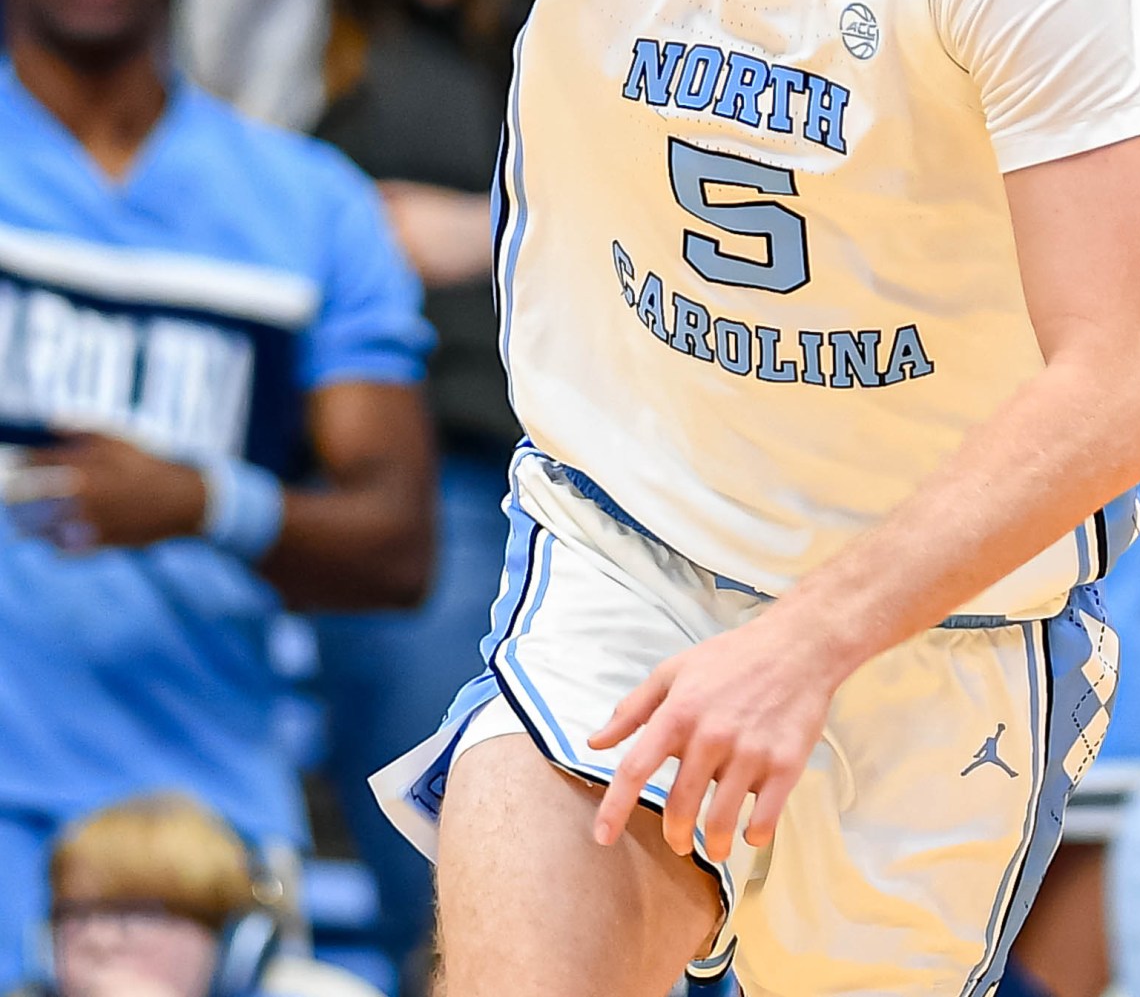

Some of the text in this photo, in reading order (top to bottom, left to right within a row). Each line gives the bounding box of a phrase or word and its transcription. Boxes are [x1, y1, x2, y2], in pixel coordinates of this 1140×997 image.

[846, 22, 877, 37] ACC
[622, 38, 850, 155] NORTH
[667, 136, 811, 294] 5
[612, 239, 934, 388] CAROLINA
